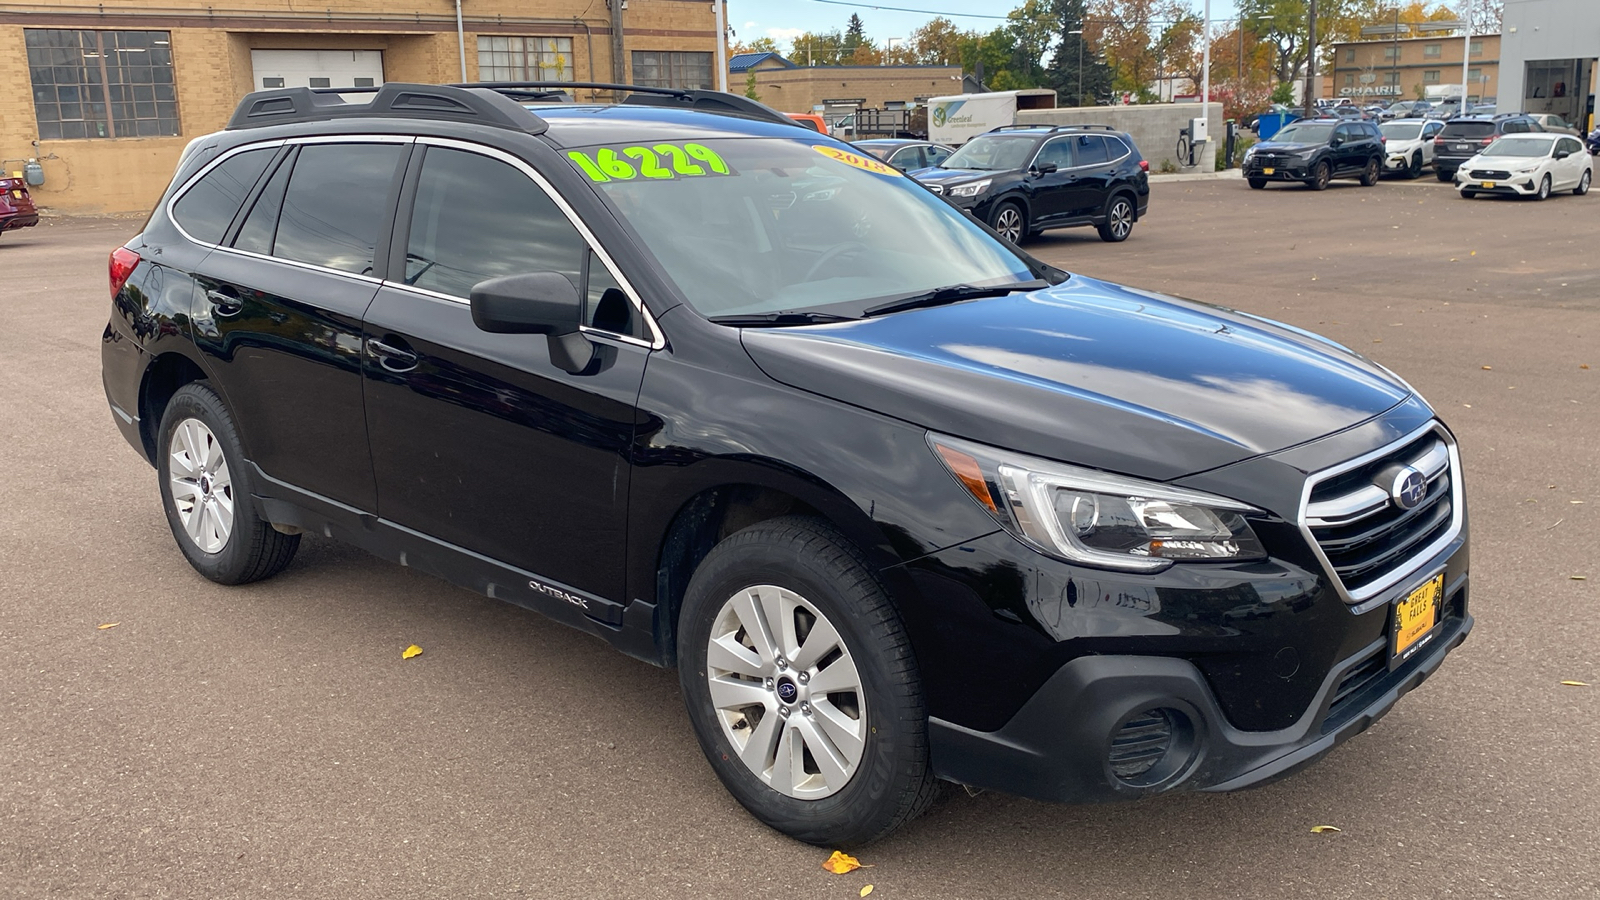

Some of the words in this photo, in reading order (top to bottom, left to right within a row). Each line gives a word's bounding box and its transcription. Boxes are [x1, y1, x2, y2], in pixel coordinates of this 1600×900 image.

[947, 114, 973, 123] Greenleaf
[567, 143, 730, 183] 16229
[831, 150, 887, 172] 2018
[529, 580, 590, 609] OUTBACK
[1410, 587, 1428, 608] GREAT
[1409, 600, 1427, 621] FALLS
